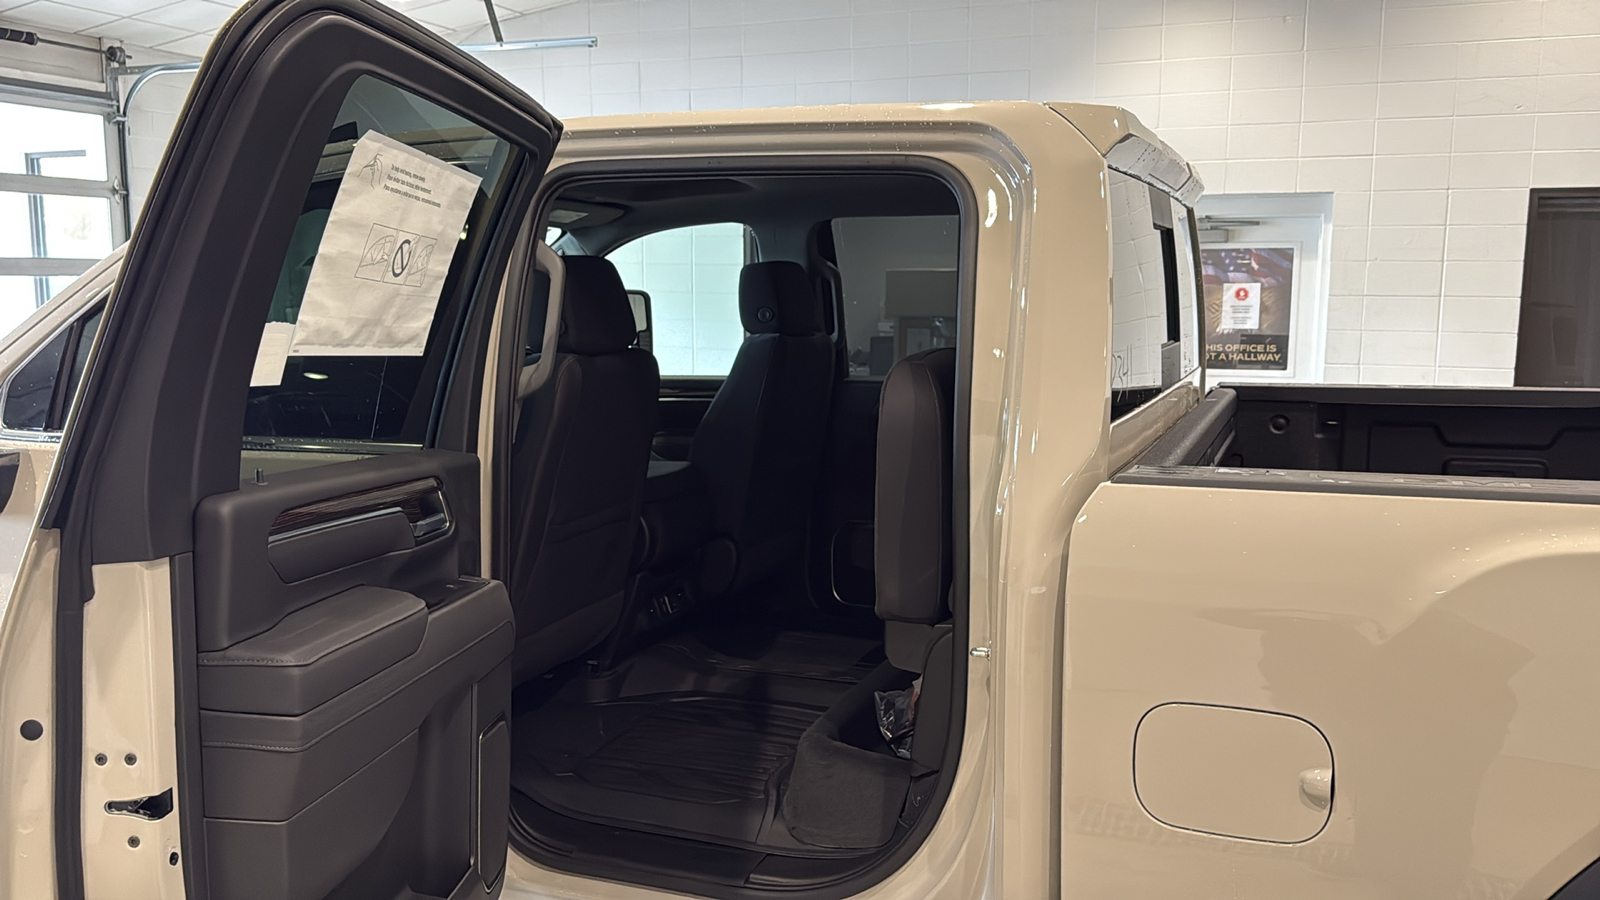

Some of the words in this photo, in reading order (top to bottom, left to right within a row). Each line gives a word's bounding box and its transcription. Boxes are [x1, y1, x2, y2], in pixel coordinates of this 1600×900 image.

[1206, 343, 1223, 352] HIS
[1225, 343, 1265, 353] OFFICE
[1266, 344, 1277, 353] IS
[1218, 352, 1227, 361] A
